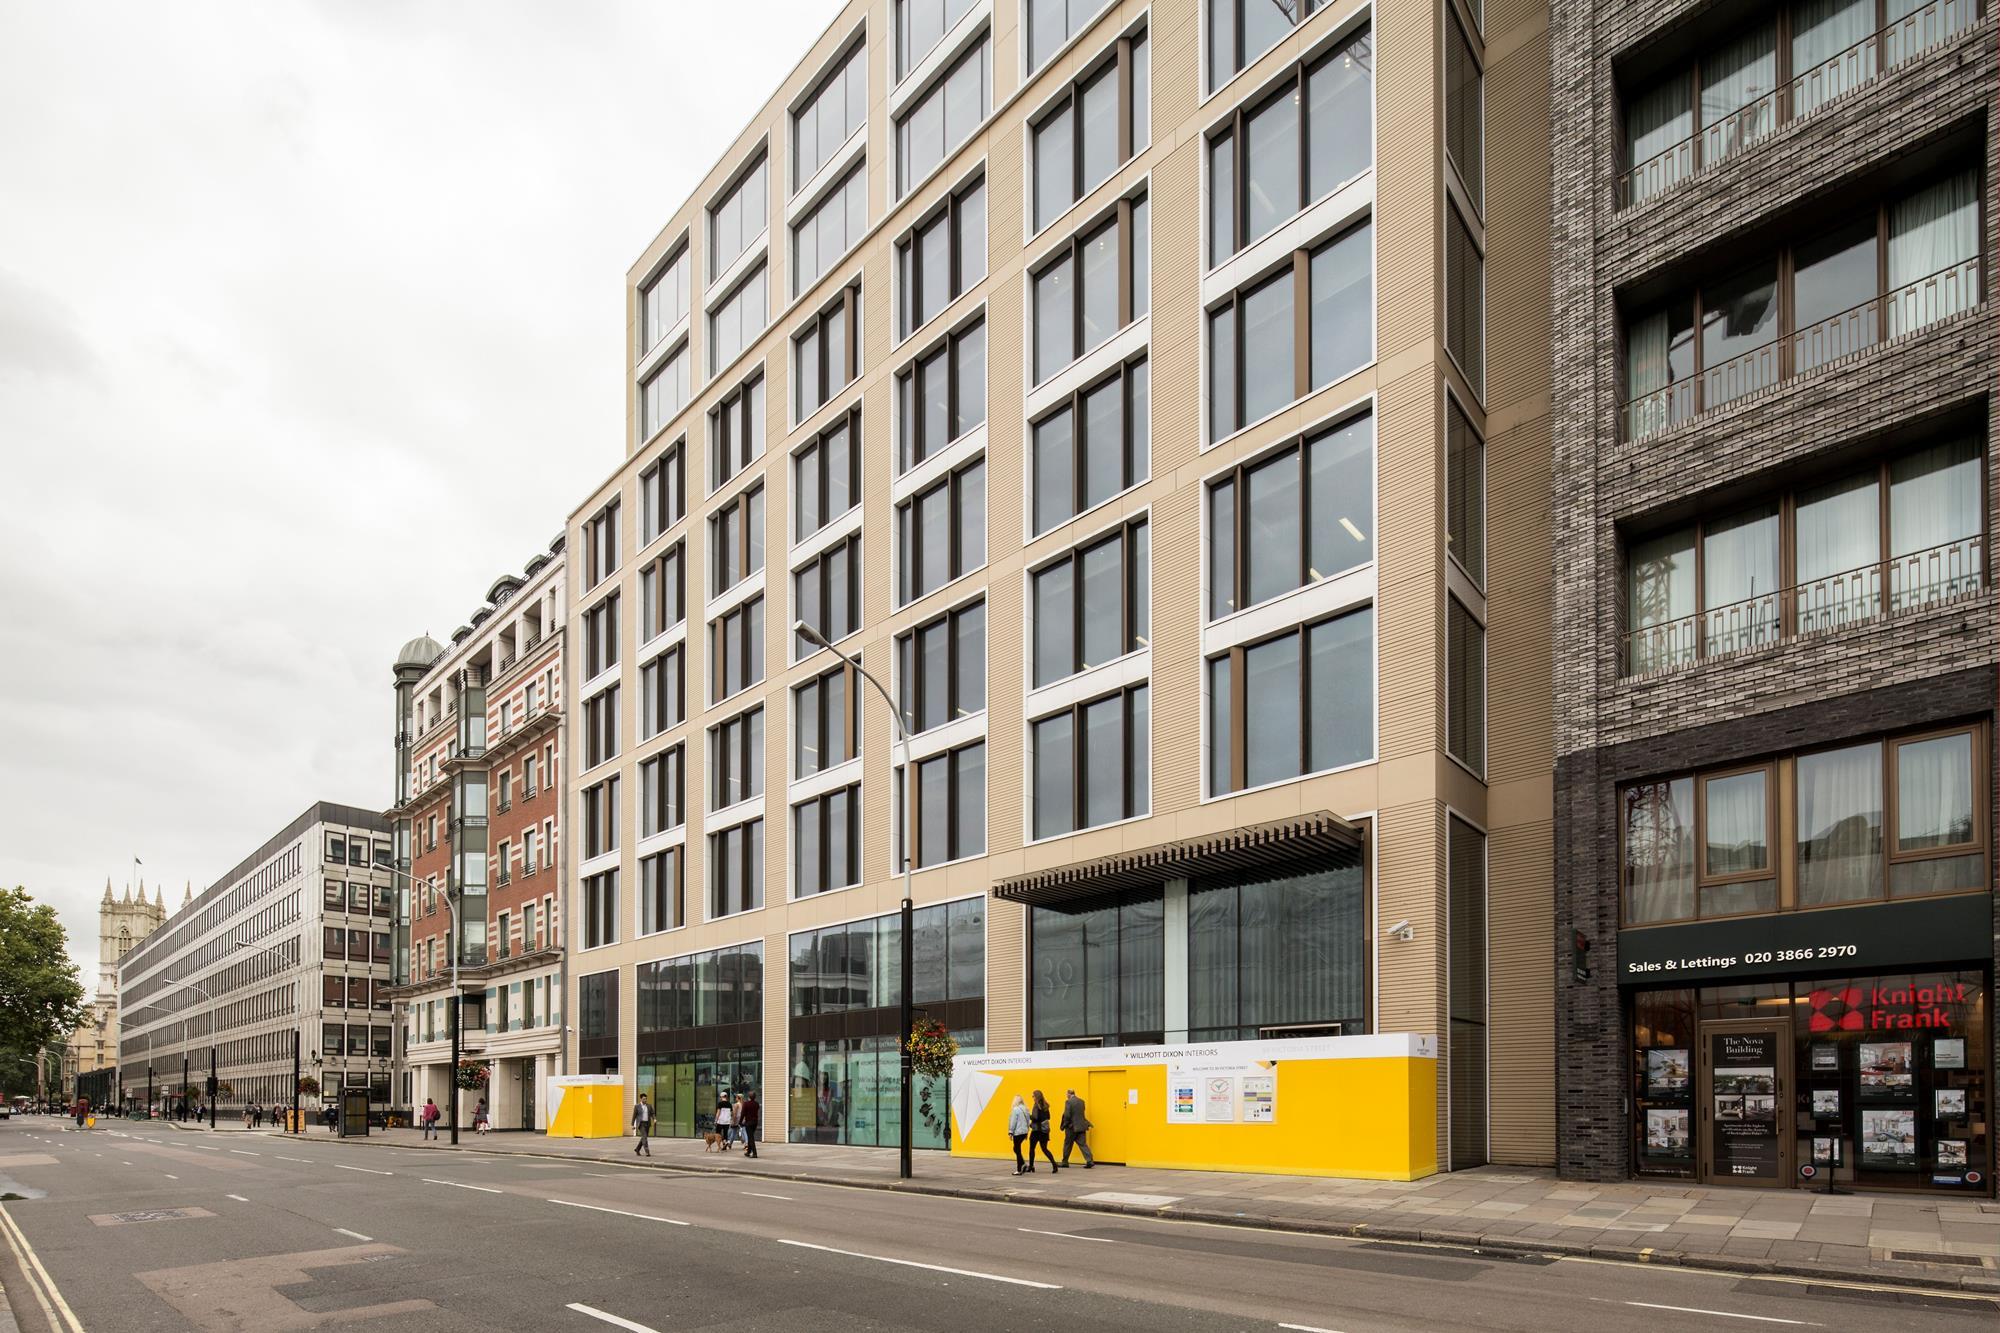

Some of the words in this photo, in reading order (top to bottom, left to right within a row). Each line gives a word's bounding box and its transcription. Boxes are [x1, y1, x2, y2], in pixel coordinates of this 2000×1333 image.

[1628, 962, 1662, 973] Sales
[1665, 959, 1678, 970] &
[1681, 955, 1737, 969] Lettings
[1744, 952, 1772, 964] 020
[1776, 948, 1814, 962] 3866
[1818, 945, 1857, 958] 2970
[1871, 983, 1968, 1009] Knight
[1871, 1008, 1951, 1030] Frank
[1724, 1037, 1740, 1046] The
[1742, 1036, 1764, 1045] Nova
[1130, 1051, 1161, 1059] WILLMOTT
[1162, 1050, 1184, 1058] DIXON
[1185, 1049, 1218, 1057] INTERIORS
[1725, 1045, 1763, 1055] Building
